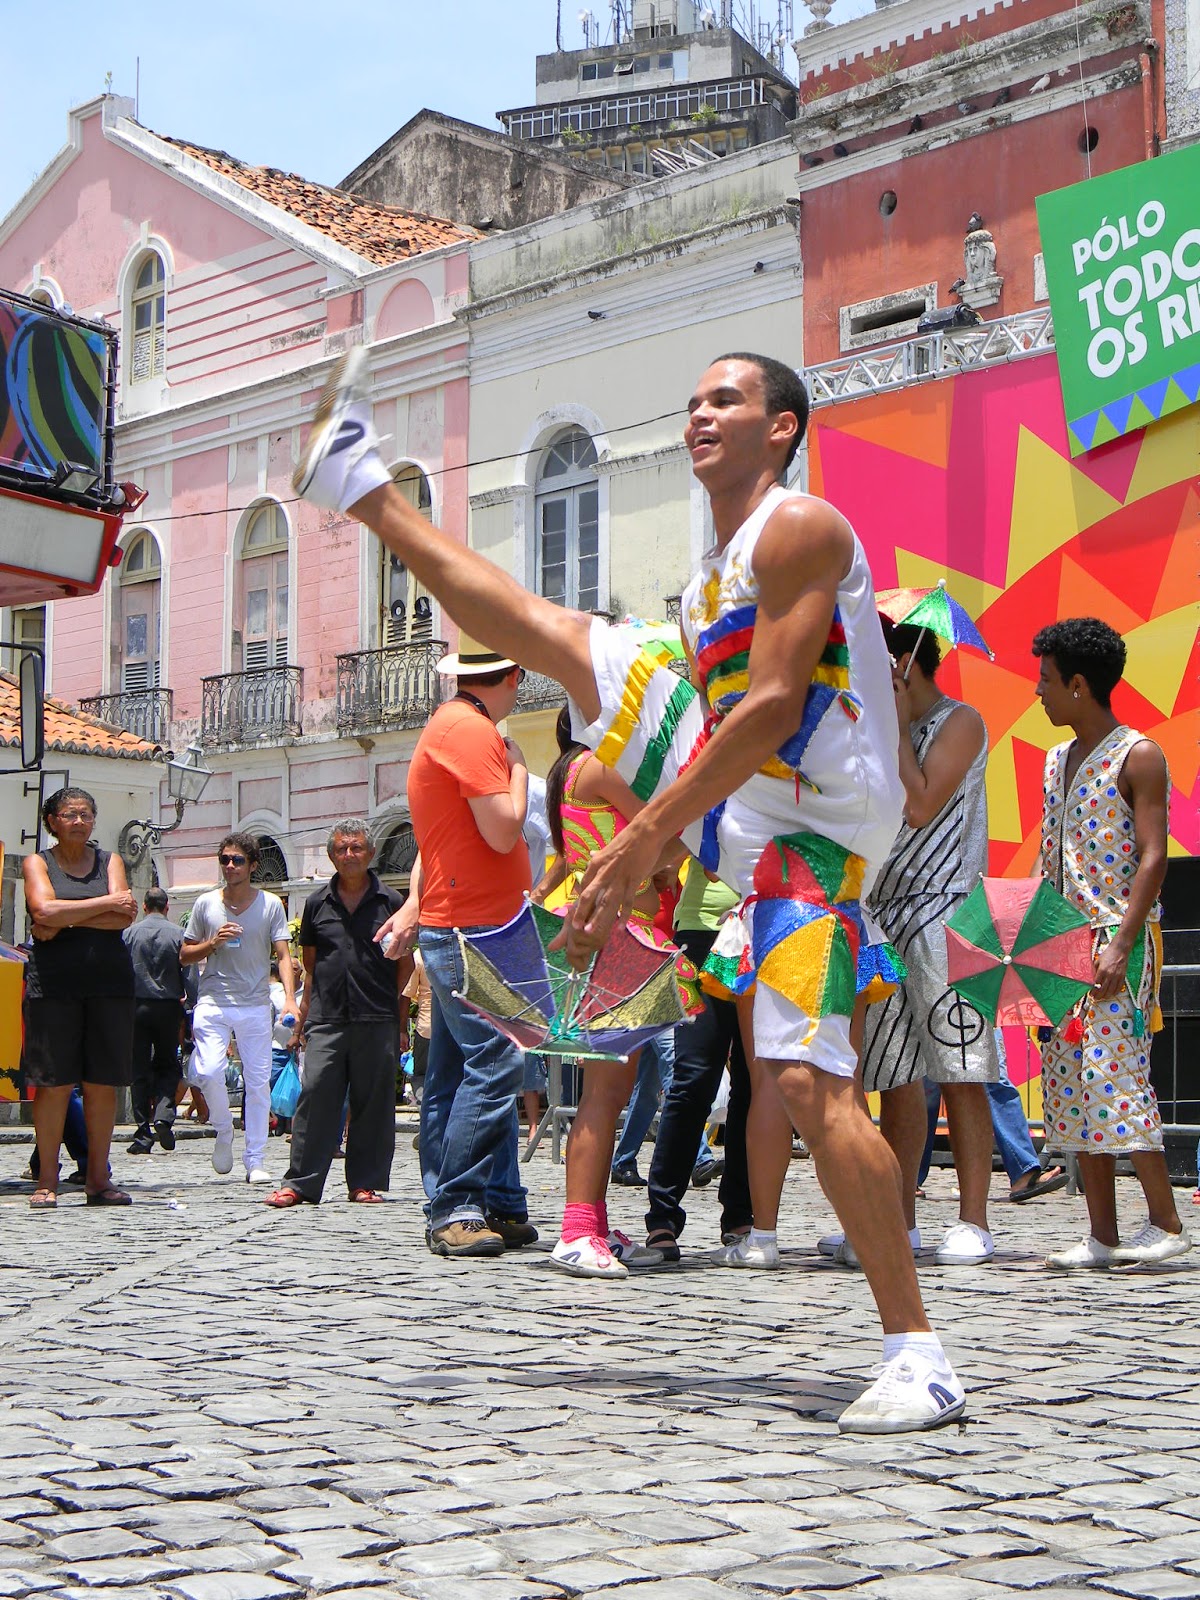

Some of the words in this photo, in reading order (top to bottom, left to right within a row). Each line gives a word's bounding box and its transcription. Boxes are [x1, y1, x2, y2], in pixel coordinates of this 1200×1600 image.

[1072, 200, 1166, 276] PÓLO
[1087, 311, 1148, 378] OS
[1157, 281, 1200, 348] RI
